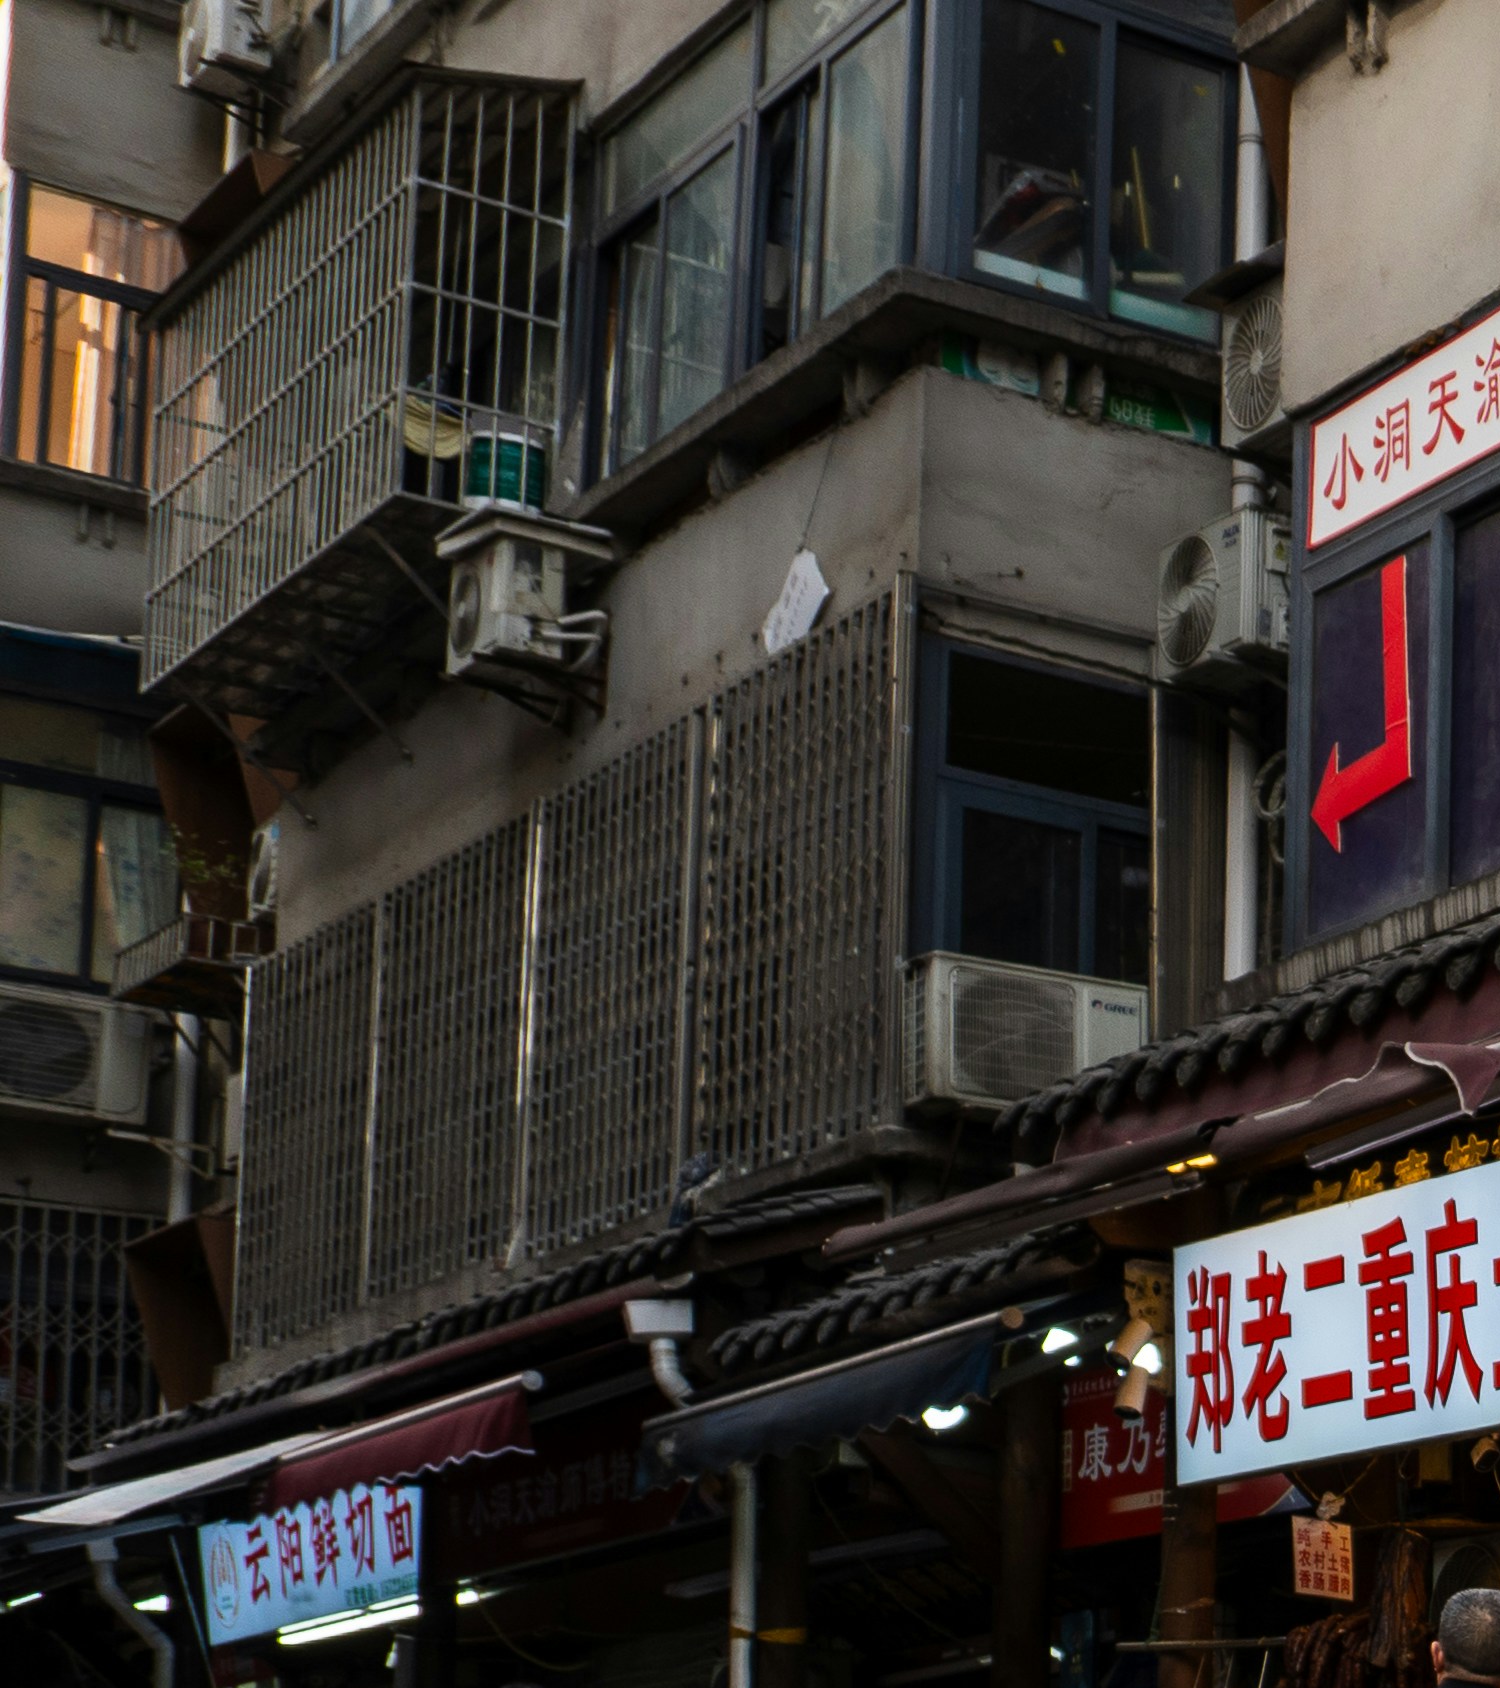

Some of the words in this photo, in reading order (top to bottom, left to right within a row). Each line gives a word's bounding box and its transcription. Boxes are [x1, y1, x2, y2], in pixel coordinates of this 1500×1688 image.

[243, 1485, 414, 1605] 云阳鲜切面
